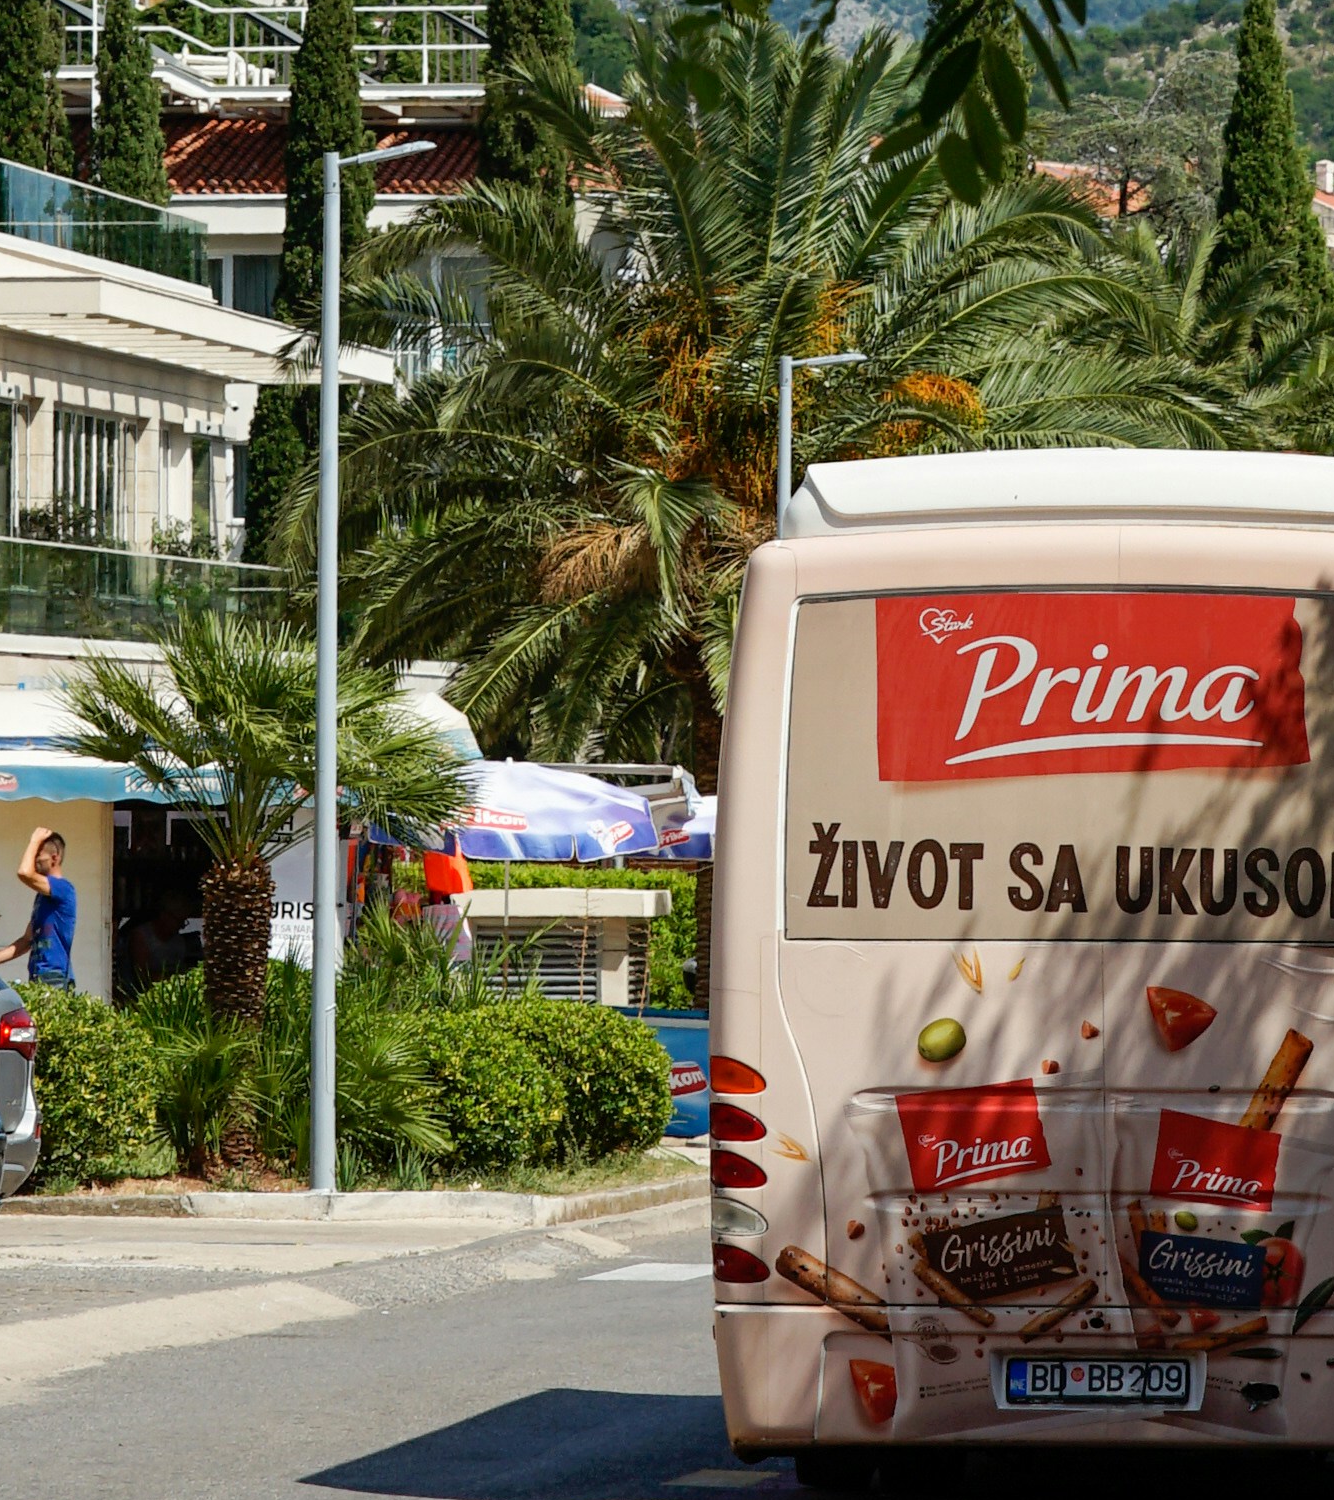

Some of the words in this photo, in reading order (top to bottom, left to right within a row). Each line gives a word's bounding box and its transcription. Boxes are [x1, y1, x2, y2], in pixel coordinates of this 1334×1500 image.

[956, 635, 1261, 741] Prima
[806, 822, 984, 909] ŽIVOT
[1008, 842, 1089, 913] SA
[931, 1136, 1032, 1179] Prima
[1171, 1159, 1263, 1196] Prima
[940, 1219, 1057, 1273] Grissini
[1149, 1239, 1255, 1279] Grissini
[1030, 1364, 1067, 1392] BD
